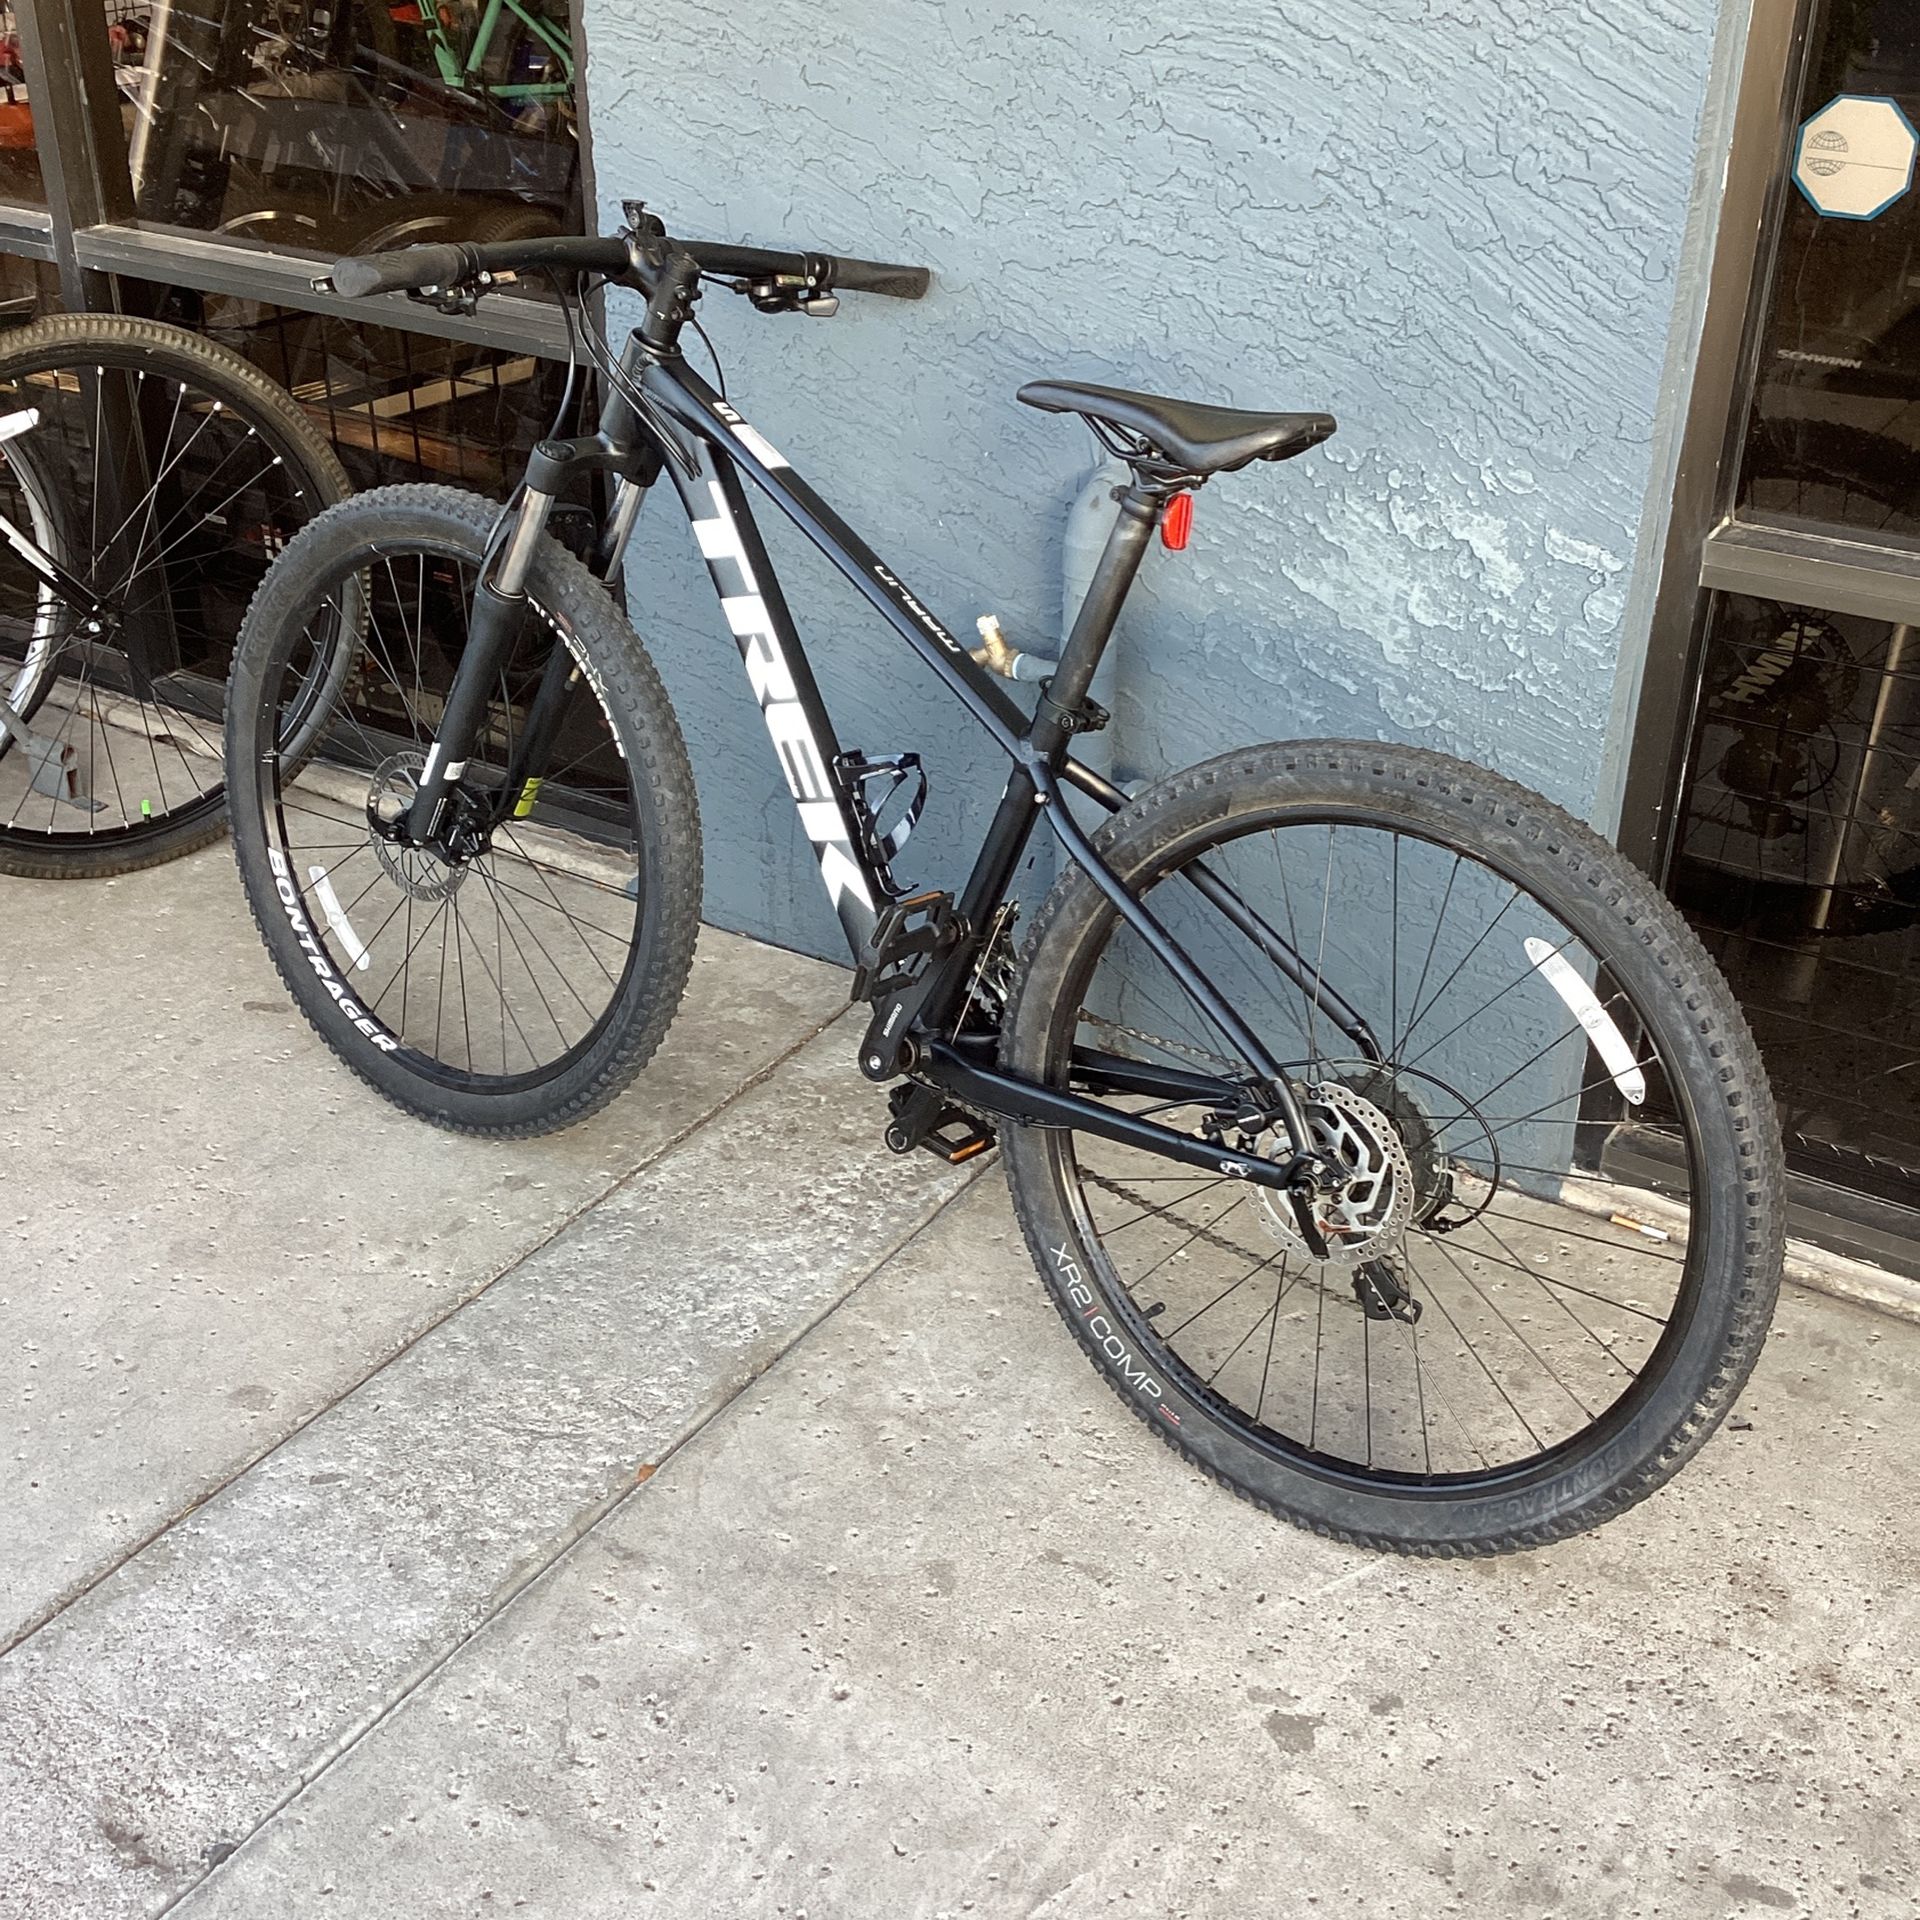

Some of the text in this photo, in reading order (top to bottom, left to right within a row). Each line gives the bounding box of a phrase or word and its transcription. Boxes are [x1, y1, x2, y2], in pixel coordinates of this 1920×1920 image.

[1777, 349, 1862, 368] SCHWINN
[713, 402, 961, 652] MARLIN 5
[692, 481, 876, 912] TREK
[1720, 623, 1823, 703] HWINN
[268, 847, 398, 1052] BONTRAGER
[882, 1003, 902, 1037] SHIMANO
[1050, 1243, 1161, 1397] XR2 COMP
